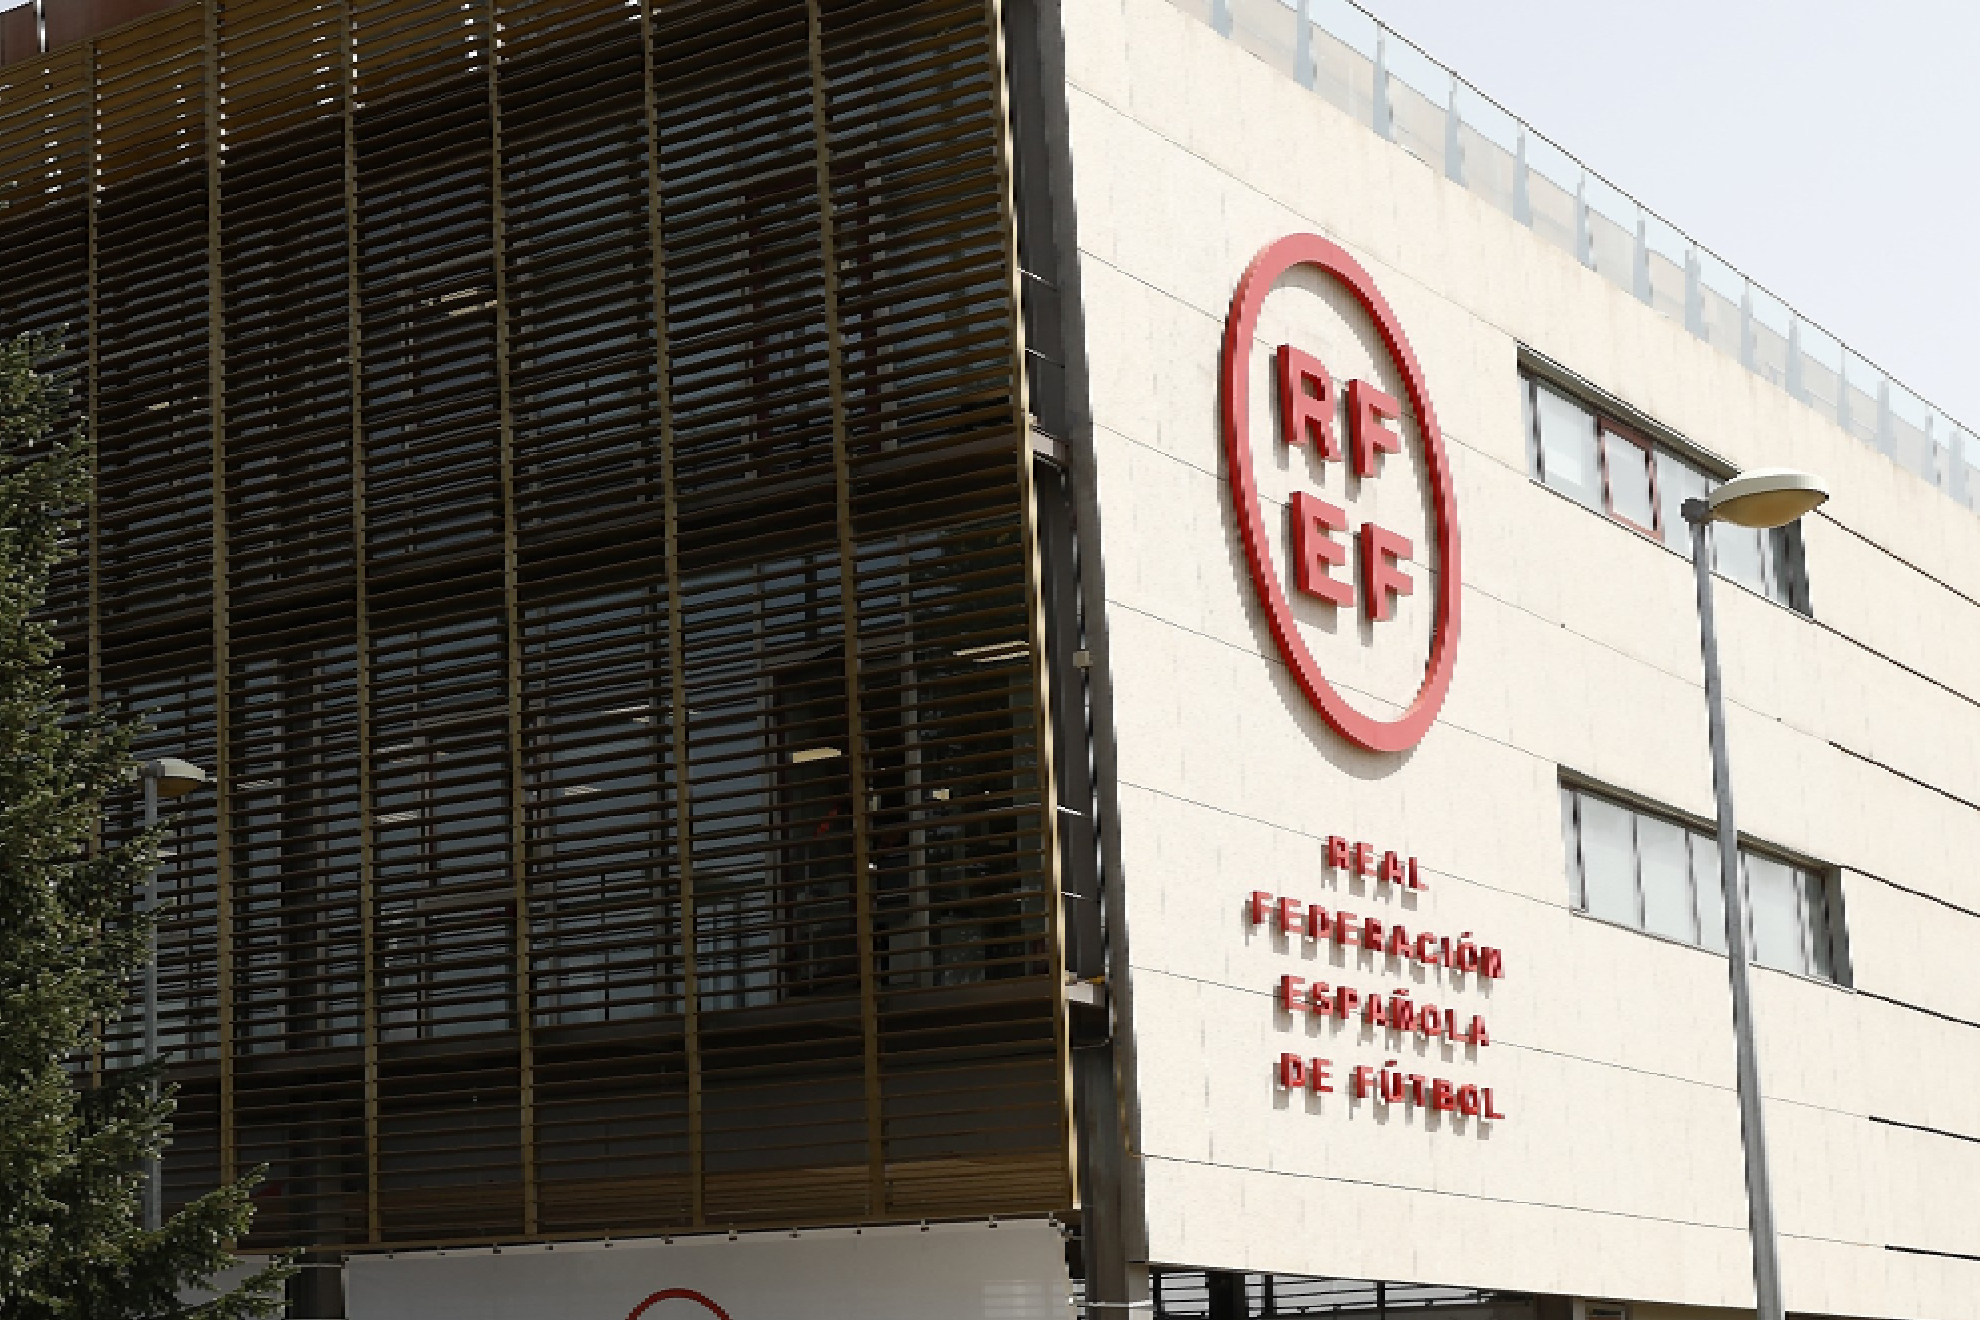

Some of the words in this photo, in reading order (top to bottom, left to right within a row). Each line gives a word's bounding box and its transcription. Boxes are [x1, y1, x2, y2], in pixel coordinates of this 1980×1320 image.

[1276, 343, 1401, 479] RF
[1288, 490, 1413, 622] EF
[1326, 835, 1429, 891] REAL
[1252, 890, 1505, 979] FEDERACIÓN
[1280, 974, 1490, 1047] ESPAÑOLA
[1280, 1052, 1334, 1093] DE
[1353, 1060, 1506, 1120] FÚTBOL
